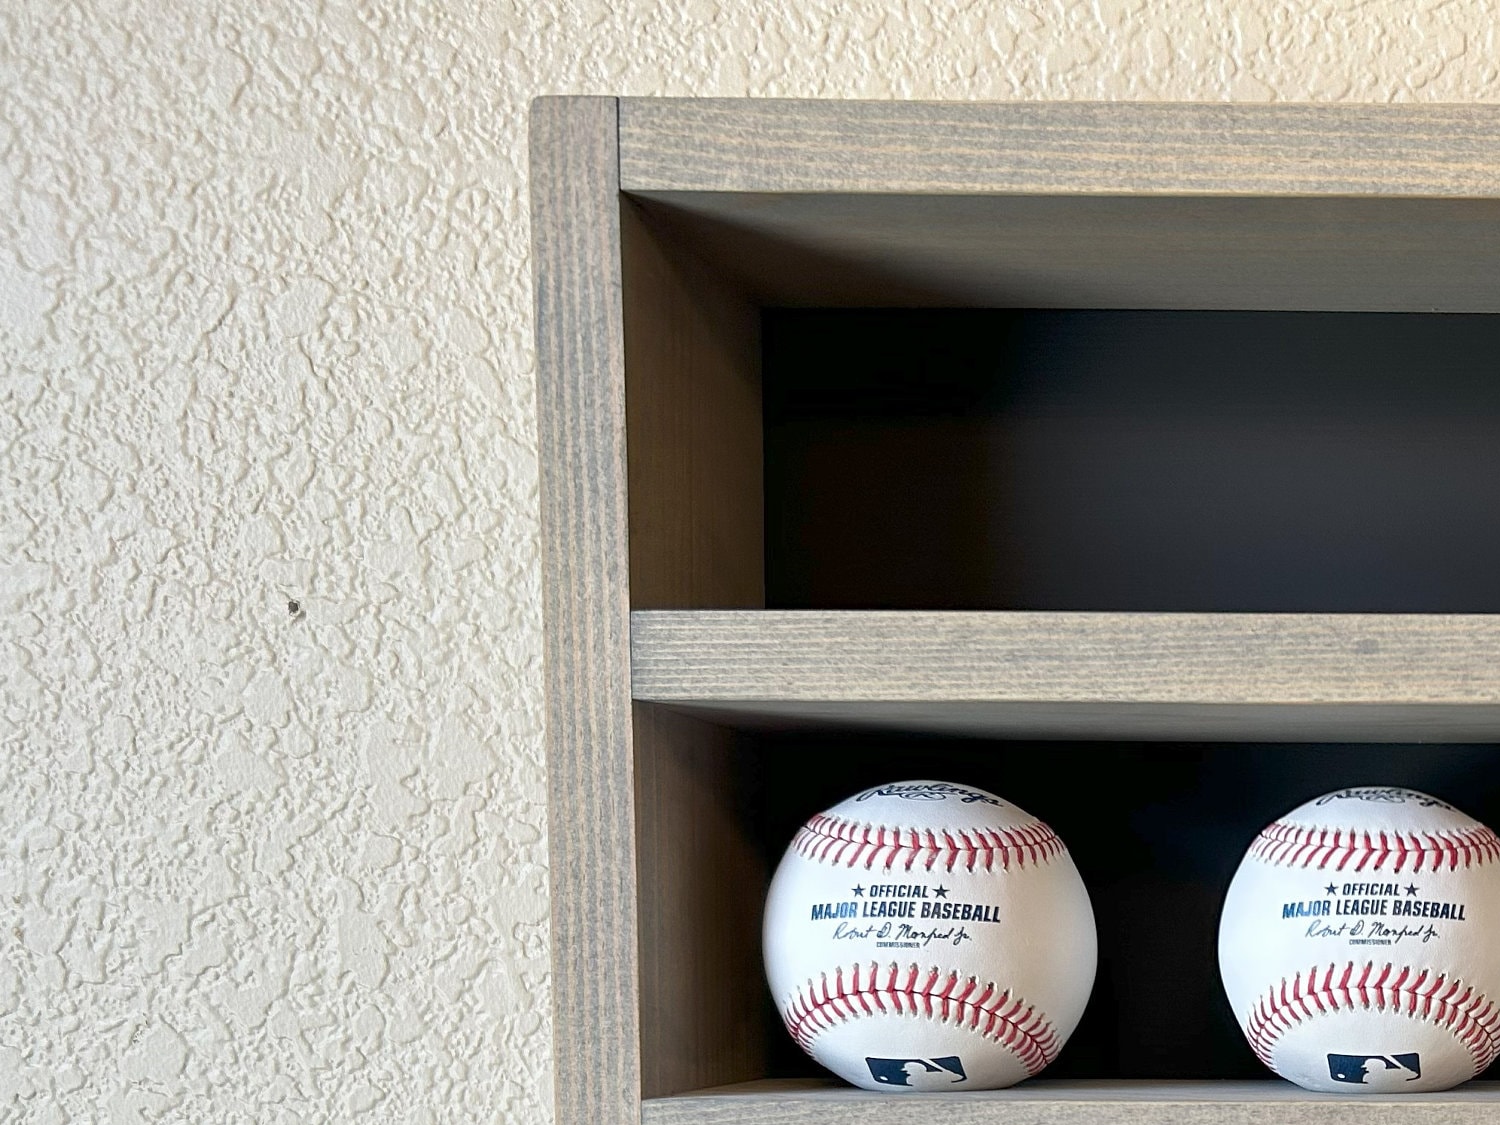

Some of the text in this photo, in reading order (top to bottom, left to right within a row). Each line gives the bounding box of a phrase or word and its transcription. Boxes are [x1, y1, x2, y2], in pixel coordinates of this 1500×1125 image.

[870, 884, 929, 898] OFFICIAL
[1342, 883, 1400, 896] OFFICIAL
[811, 901, 1001, 923] MAJOR LEAGUE BASEBALL
[1282, 899, 1465, 921] MAJOR LEAGUE BASEBALL
